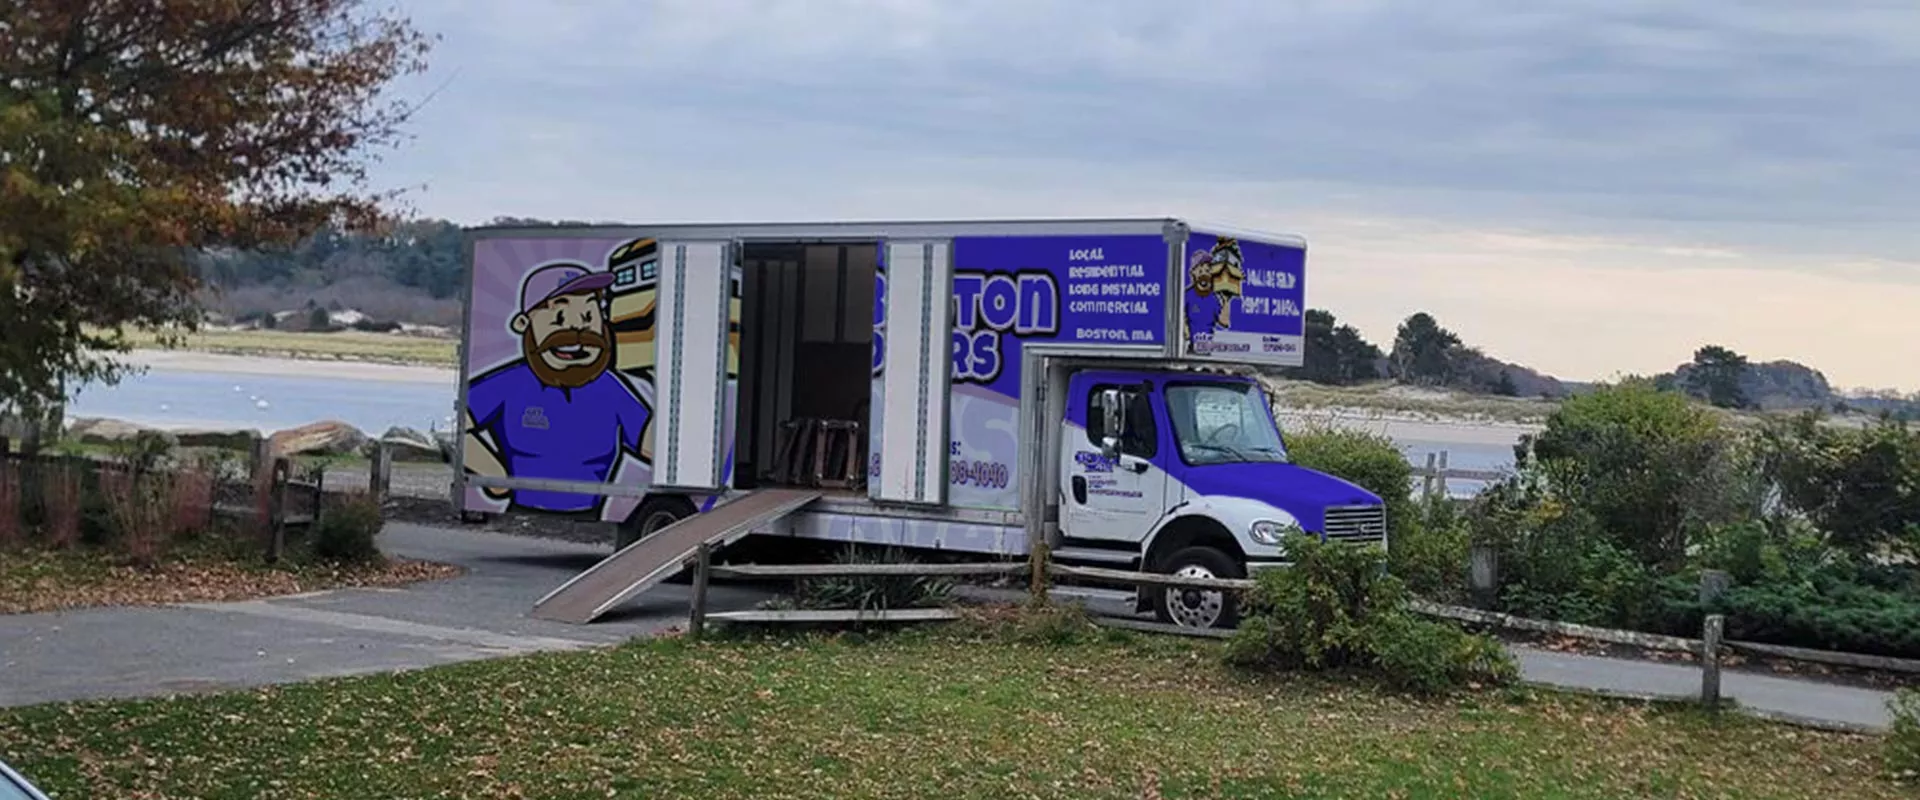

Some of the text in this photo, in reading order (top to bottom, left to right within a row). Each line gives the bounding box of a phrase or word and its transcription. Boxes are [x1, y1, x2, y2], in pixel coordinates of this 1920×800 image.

[1069, 248, 1104, 261] LOCAL
[1069, 264, 1145, 278] RESIDENTIAL
[1069, 282, 1161, 296] LONG DISTANCE
[1069, 300, 1149, 314] COMMERCIAL
[1131, 330, 1154, 341] MA
